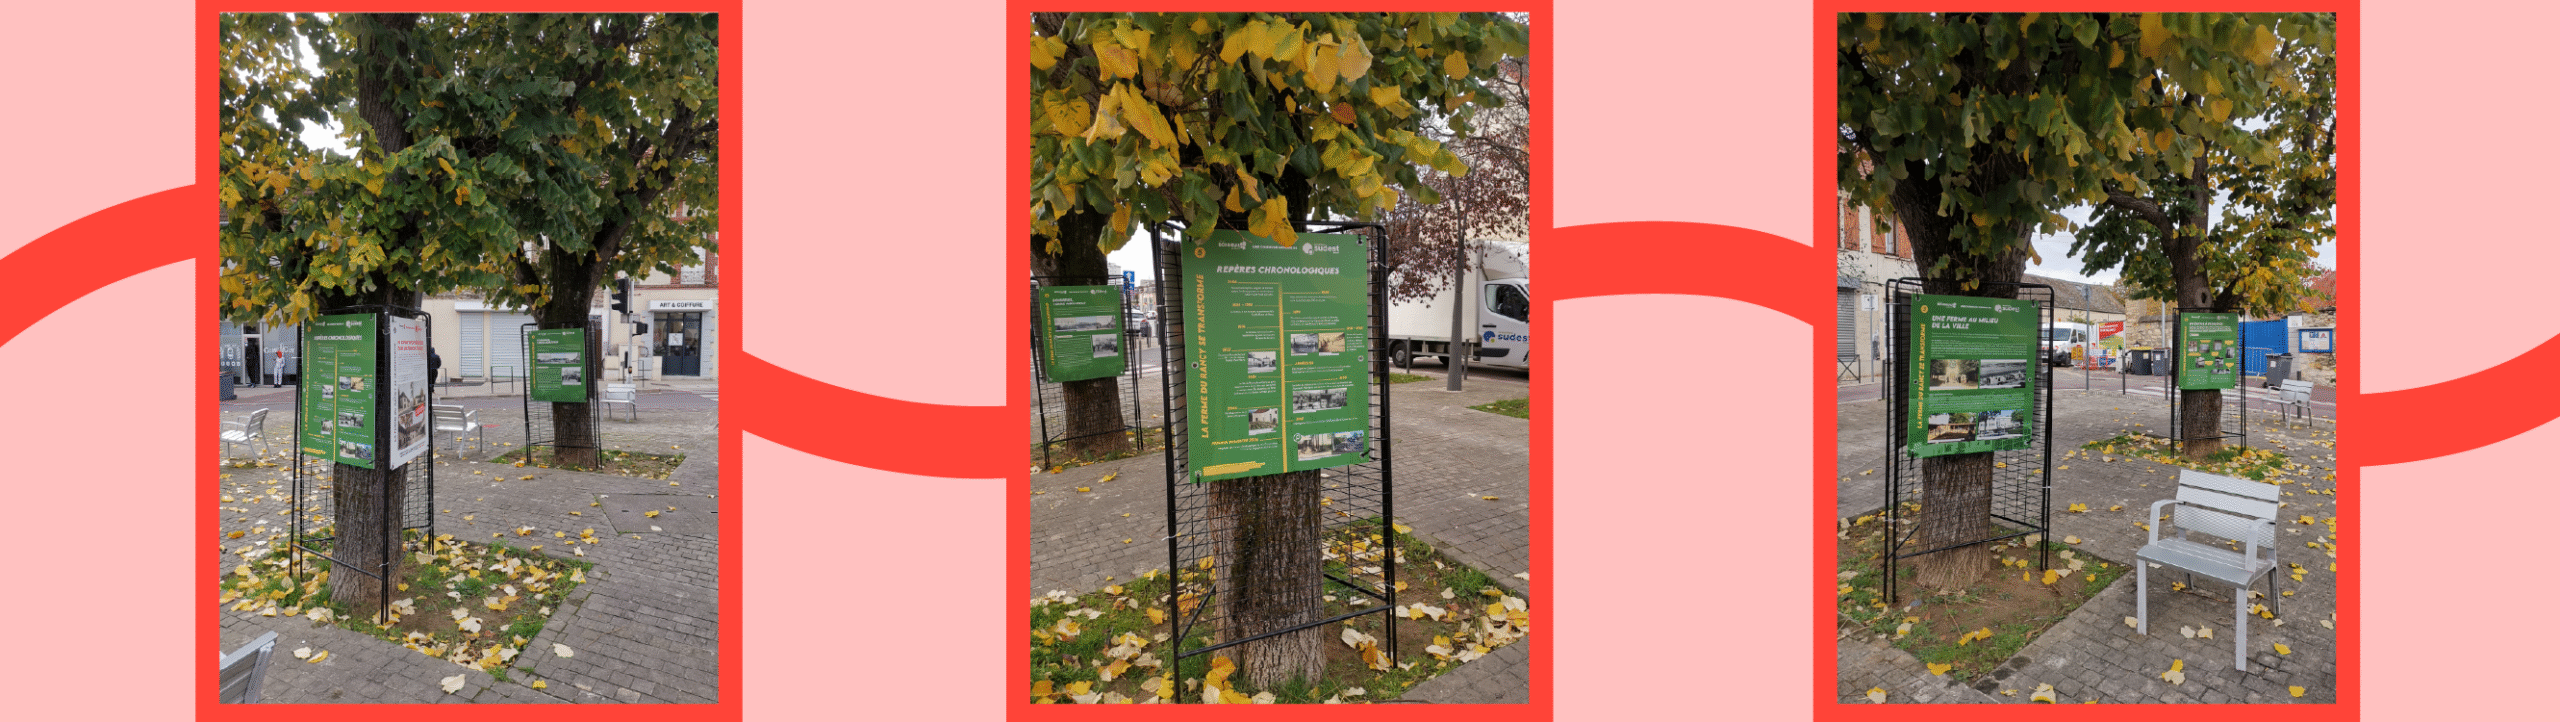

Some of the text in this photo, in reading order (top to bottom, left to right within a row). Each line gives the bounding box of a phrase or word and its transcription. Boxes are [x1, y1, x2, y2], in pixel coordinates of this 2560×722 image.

[1216, 264, 1340, 275] REPÈRES CHRONOLOGIQUES
[1498, 334, 1529, 342] sudes
[1196, 274, 1209, 438] LA FERME DU RANCY SE TRANSFORME
